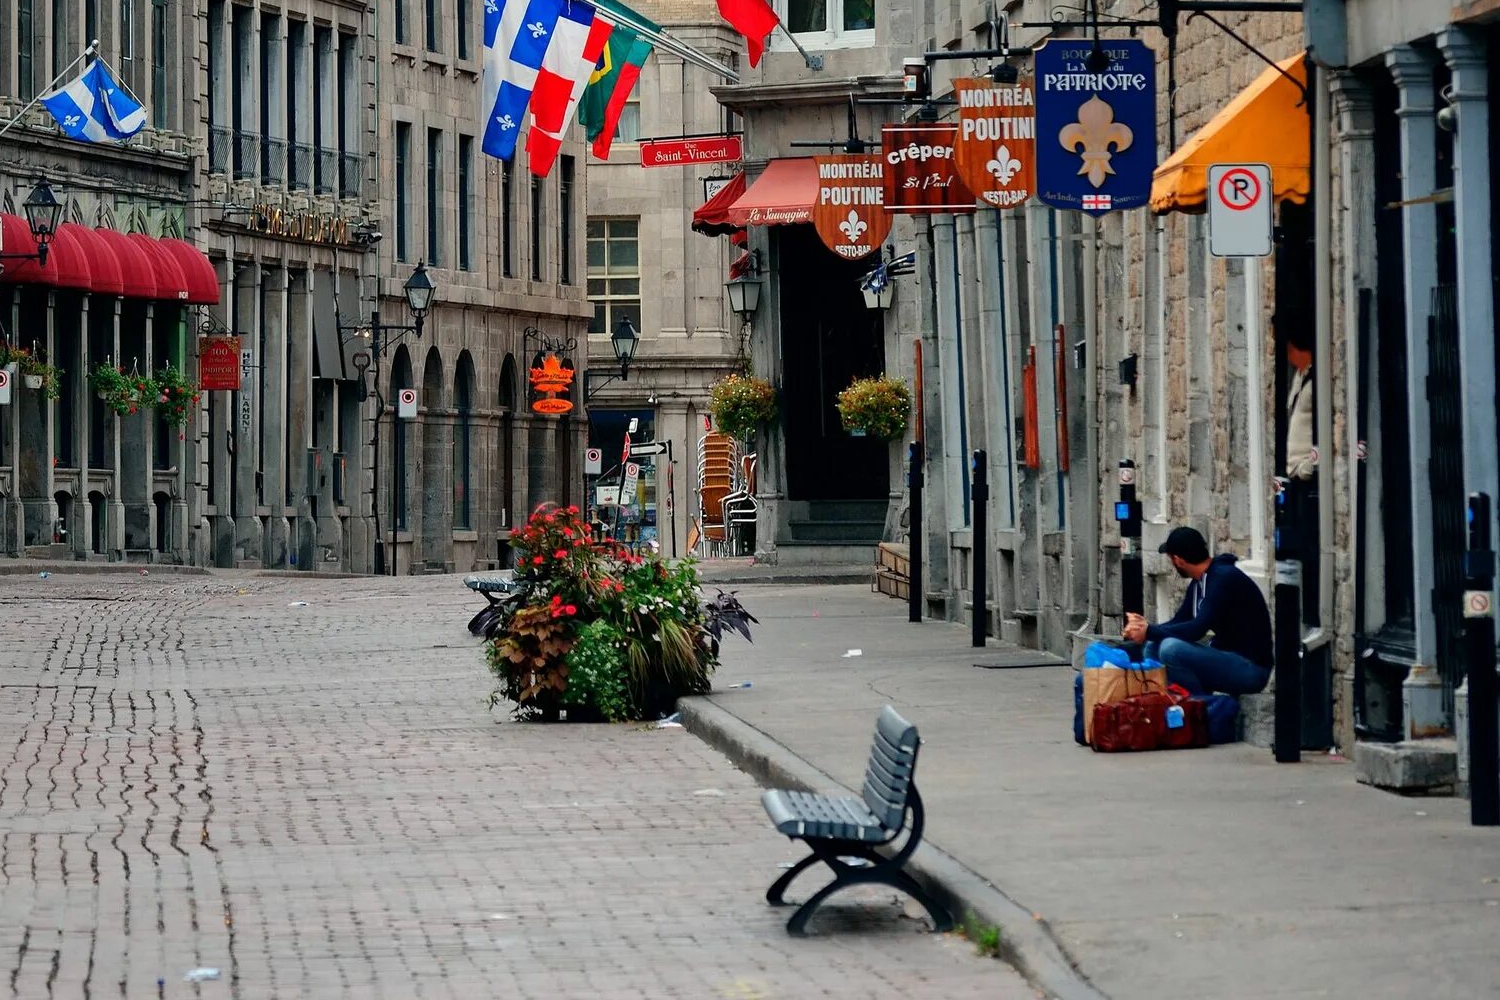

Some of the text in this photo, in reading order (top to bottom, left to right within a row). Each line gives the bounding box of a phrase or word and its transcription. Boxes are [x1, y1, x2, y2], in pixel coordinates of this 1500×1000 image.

[1067, 63, 1078, 71] La
[1113, 62, 1124, 71] du
[1044, 73, 1146, 91] PATRIOTE
[960, 83, 1034, 108] MONTRÉA
[962, 117, 1035, 141] POUTIN
[655, 147, 728, 162] Saint-Vincent
[819, 161, 883, 179] MONTRÉAL
[902, 173, 953, 190] St Paul
[821, 186, 883, 205] POUTINE
[982, 190, 1027, 205] RESTO-BAR
[746, 208, 810, 223] La Sauvagine
[835, 244, 871, 258] RESTO-BAR
